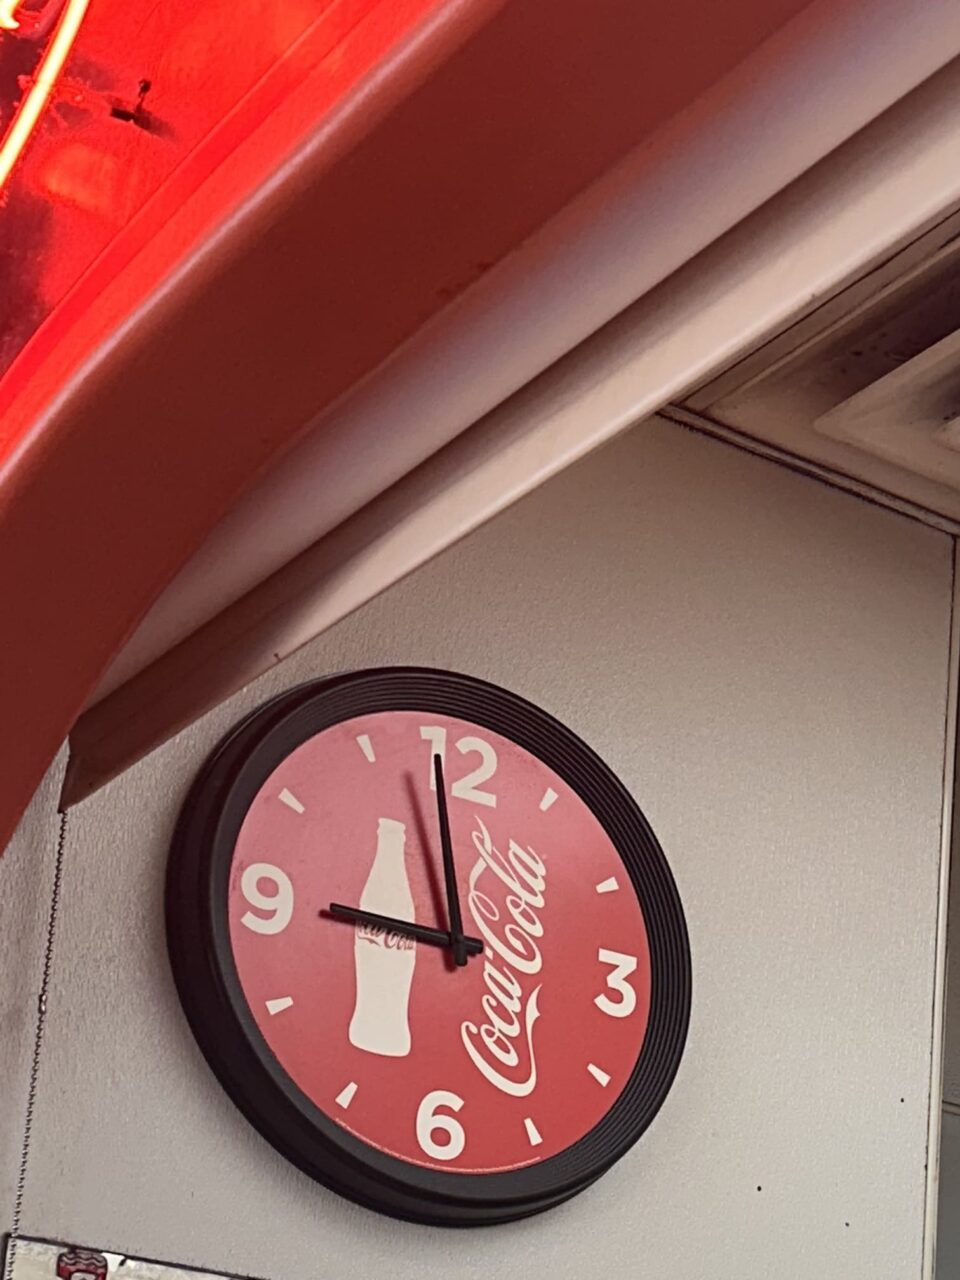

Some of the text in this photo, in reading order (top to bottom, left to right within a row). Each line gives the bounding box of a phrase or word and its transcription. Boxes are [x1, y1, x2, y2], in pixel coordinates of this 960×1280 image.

[419, 726, 498, 808] 12
[240, 863, 294, 935] 9
[461, 815, 547, 1097] Coca-Cola
[593, 948, 637, 1019] 3
[415, 1089, 465, 1161] 6
